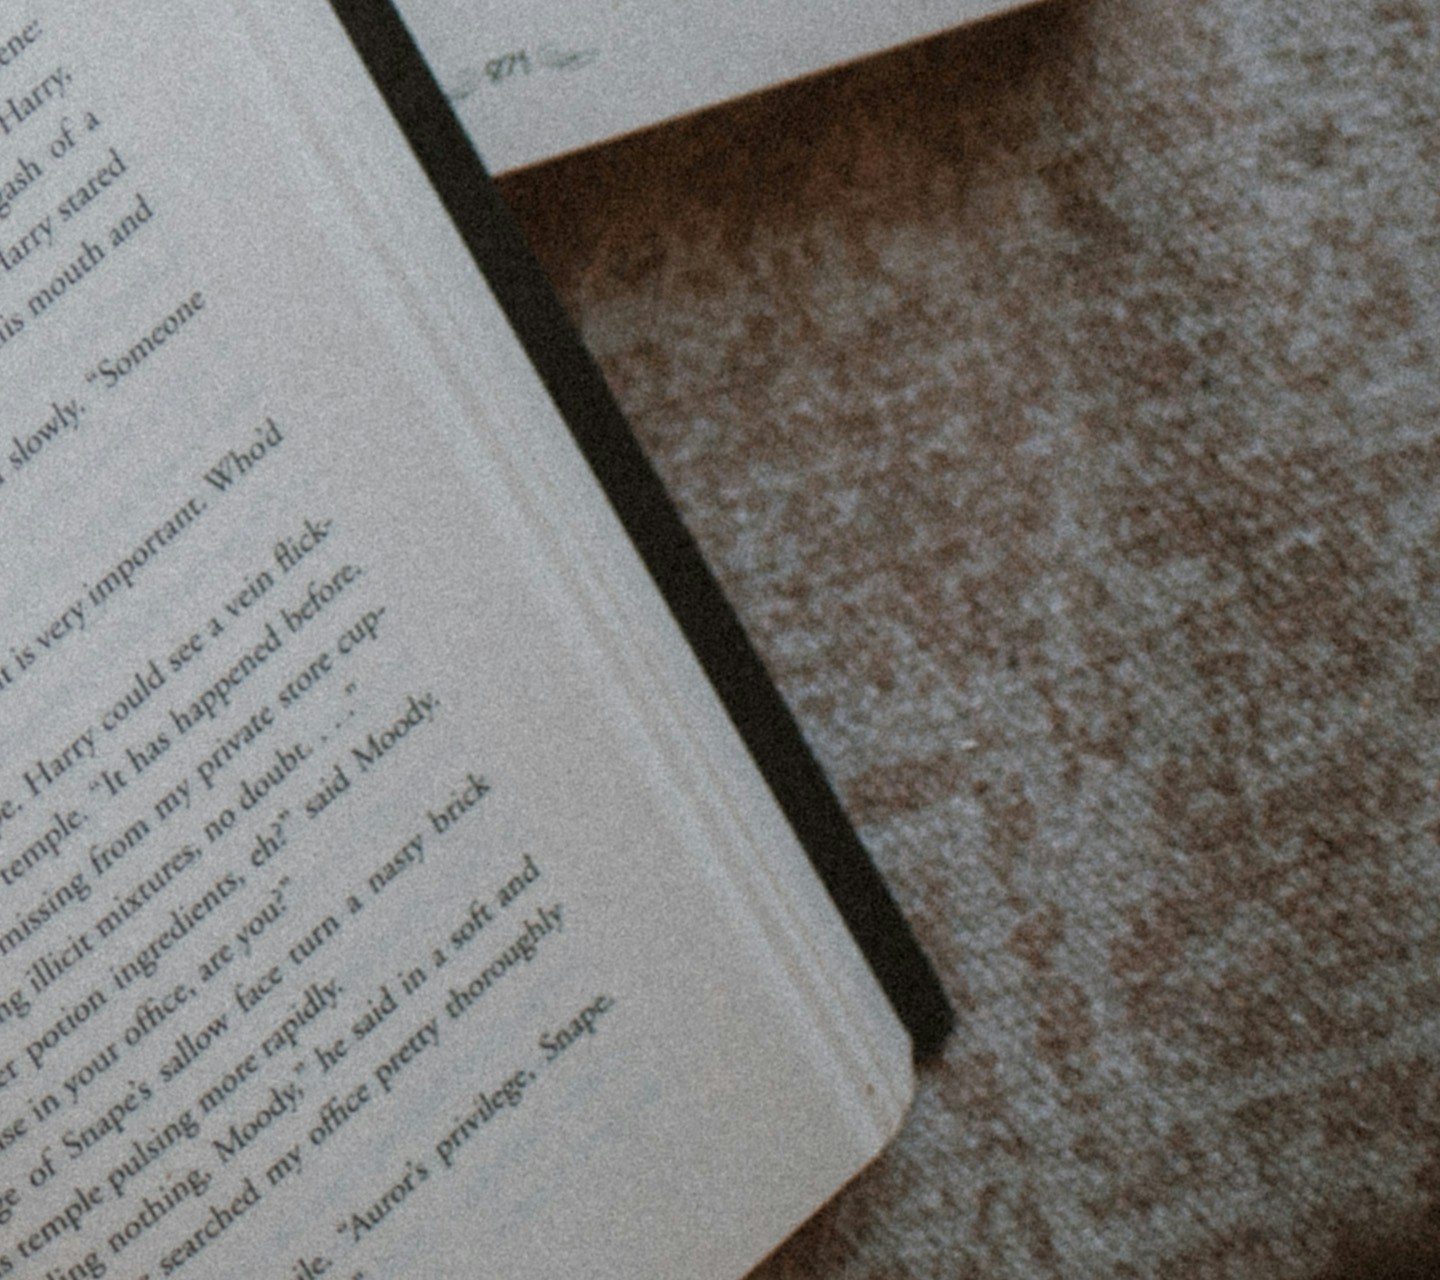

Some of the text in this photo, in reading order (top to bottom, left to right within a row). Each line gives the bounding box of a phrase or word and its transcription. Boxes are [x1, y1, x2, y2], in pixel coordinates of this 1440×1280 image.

[334, 993, 616, 1244] “Auror’s privilege, Snape.
